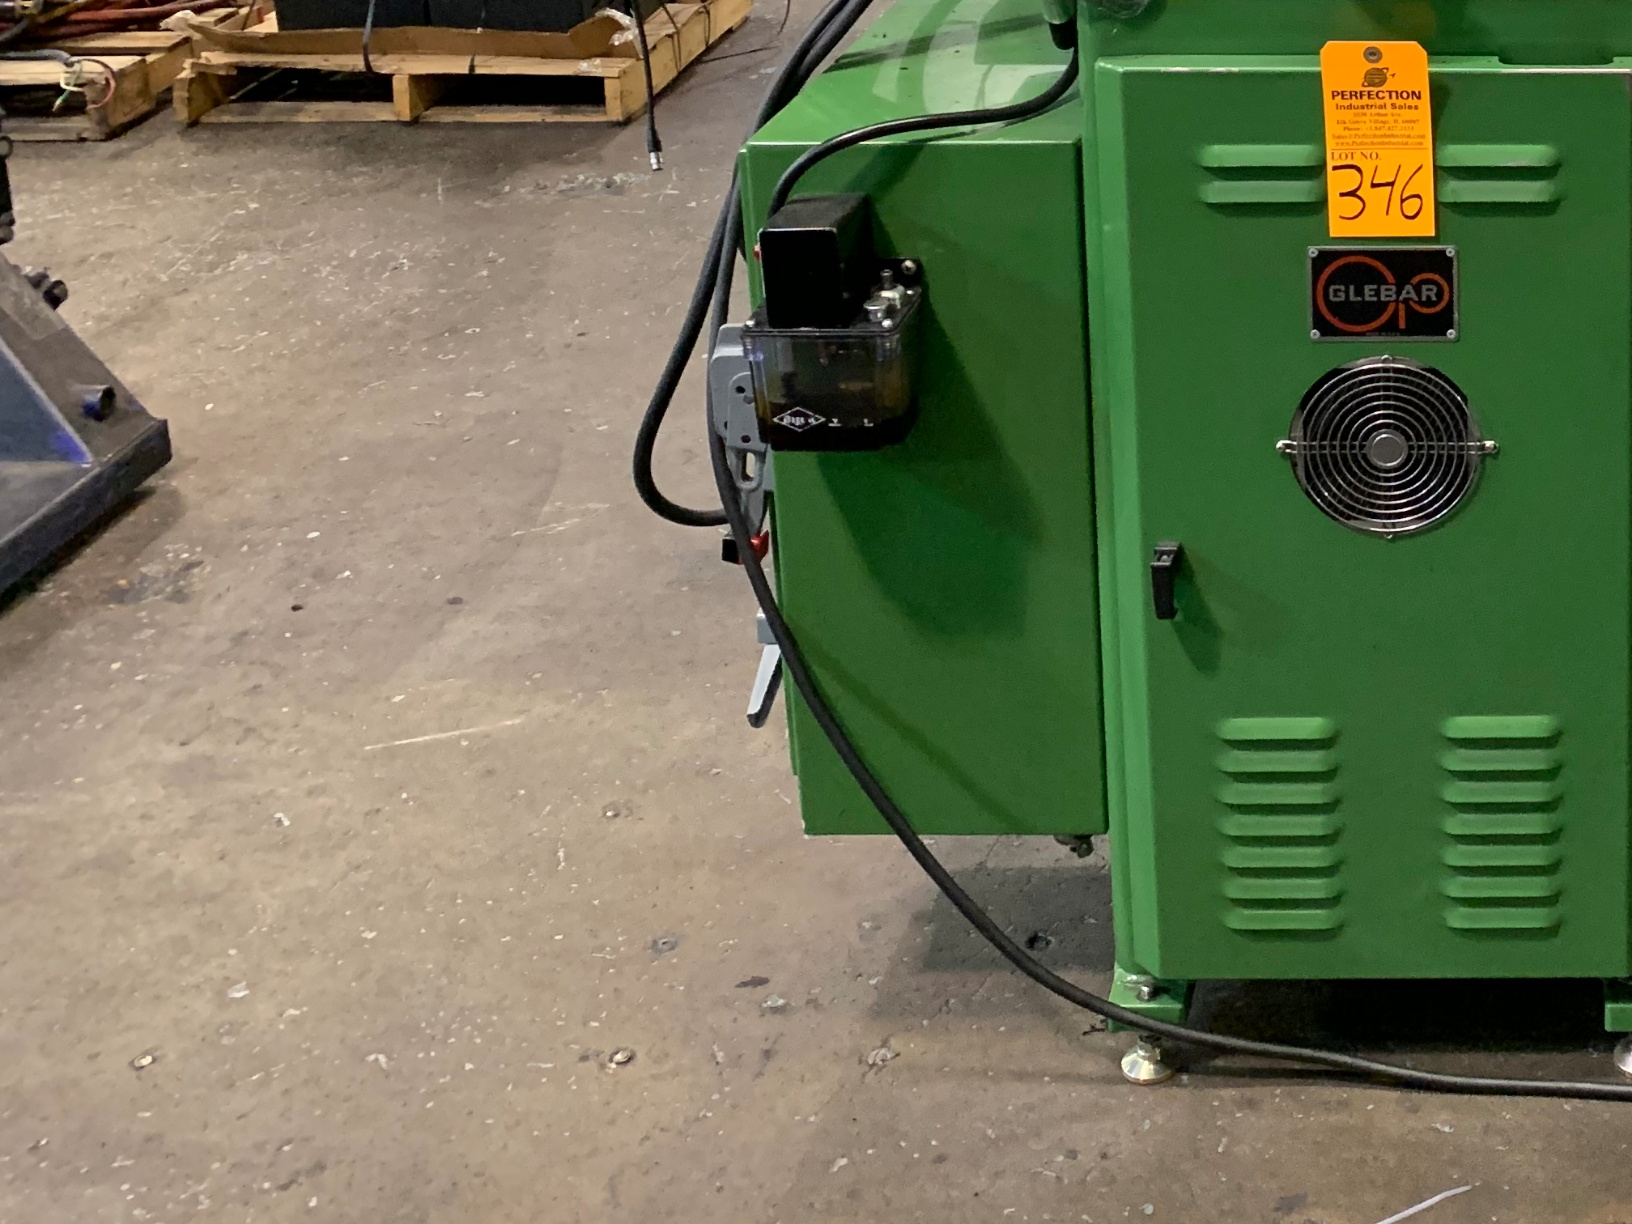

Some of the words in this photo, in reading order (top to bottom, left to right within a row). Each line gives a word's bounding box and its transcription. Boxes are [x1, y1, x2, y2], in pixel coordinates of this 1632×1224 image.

[1331, 90, 1422, 101] PERFECTION
[1390, 102, 1419, 110] Sales
[1331, 152, 1356, 161] LOT
[1360, 151, 1382, 160] NO.
[1332, 164, 1424, 220] 346
[1329, 284, 1438, 302] GLEBAR
